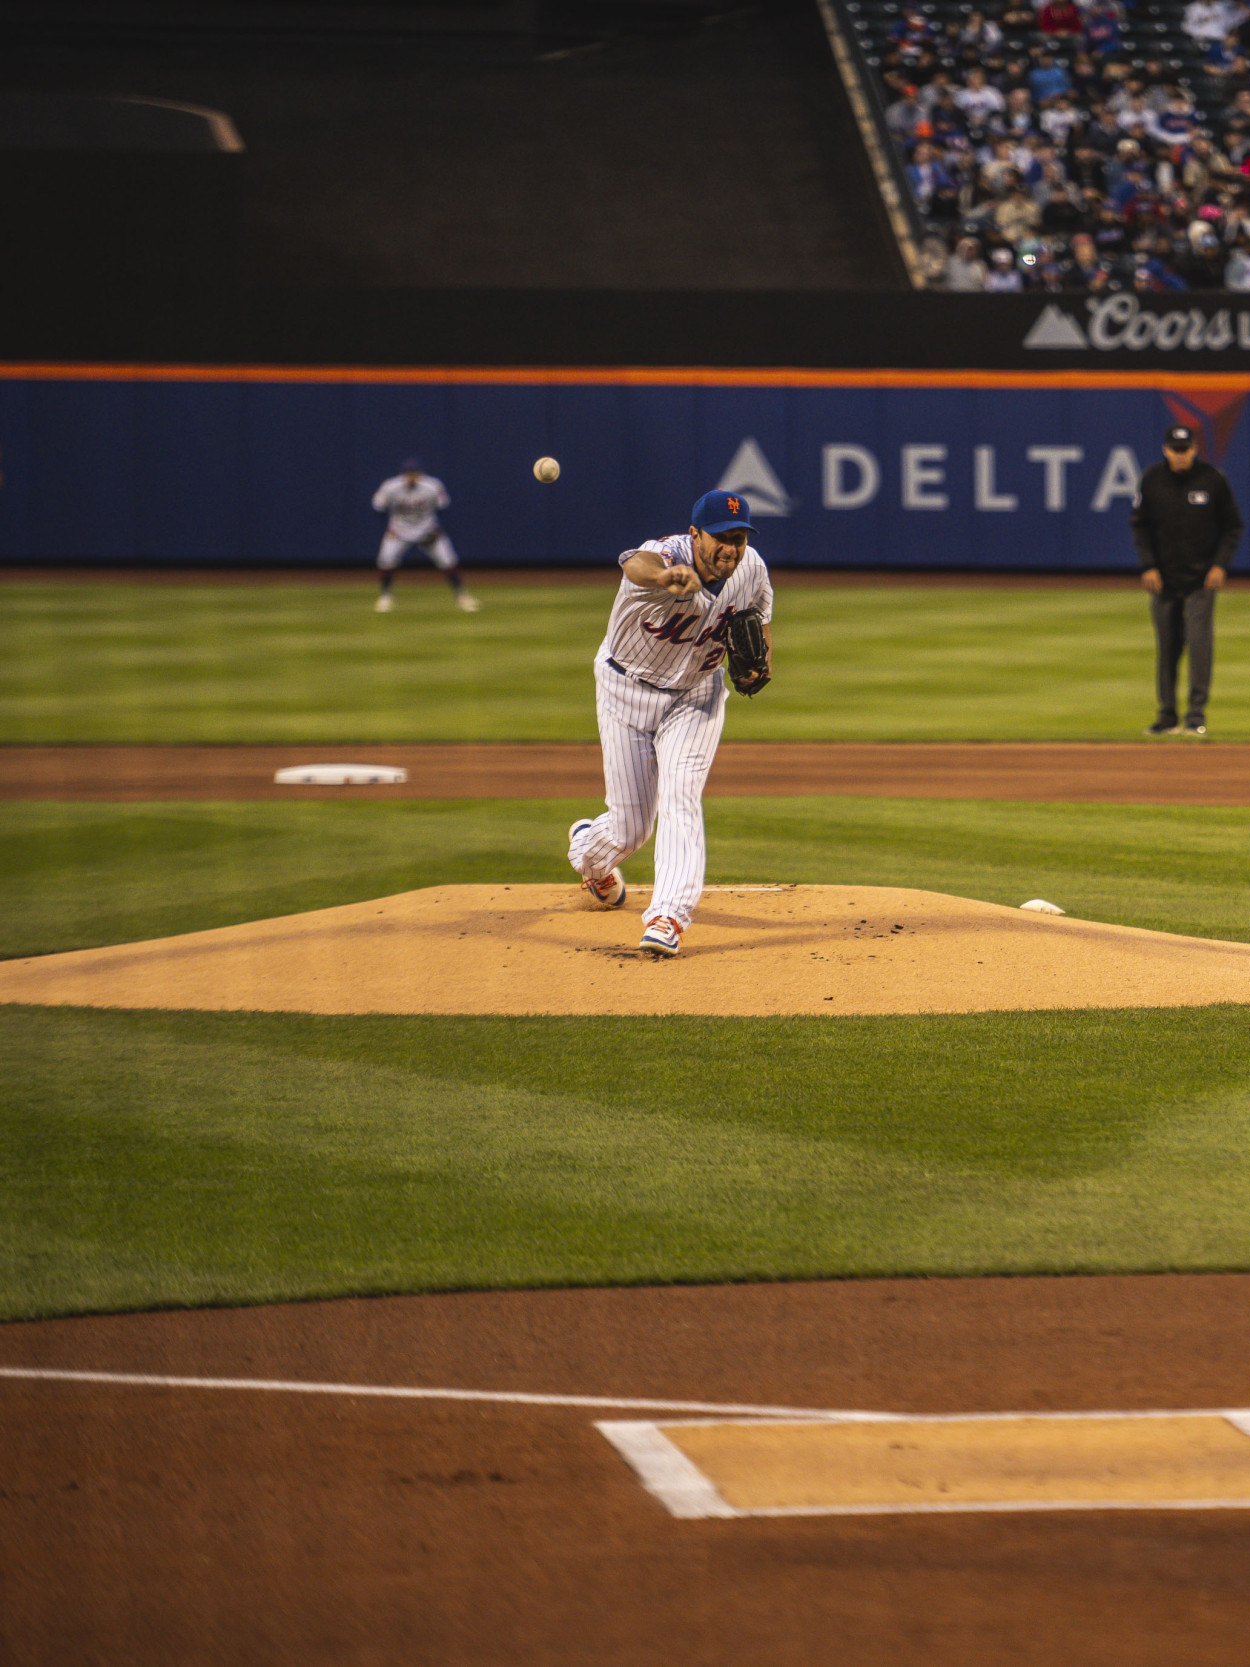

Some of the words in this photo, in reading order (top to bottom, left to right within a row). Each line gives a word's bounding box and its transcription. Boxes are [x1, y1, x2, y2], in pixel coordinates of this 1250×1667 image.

[1087, 294, 1234, 350] Coors
[822, 443, 1141, 512] DELTA
[727, 497, 740, 514] NY
[643, 605, 737, 647] Met
